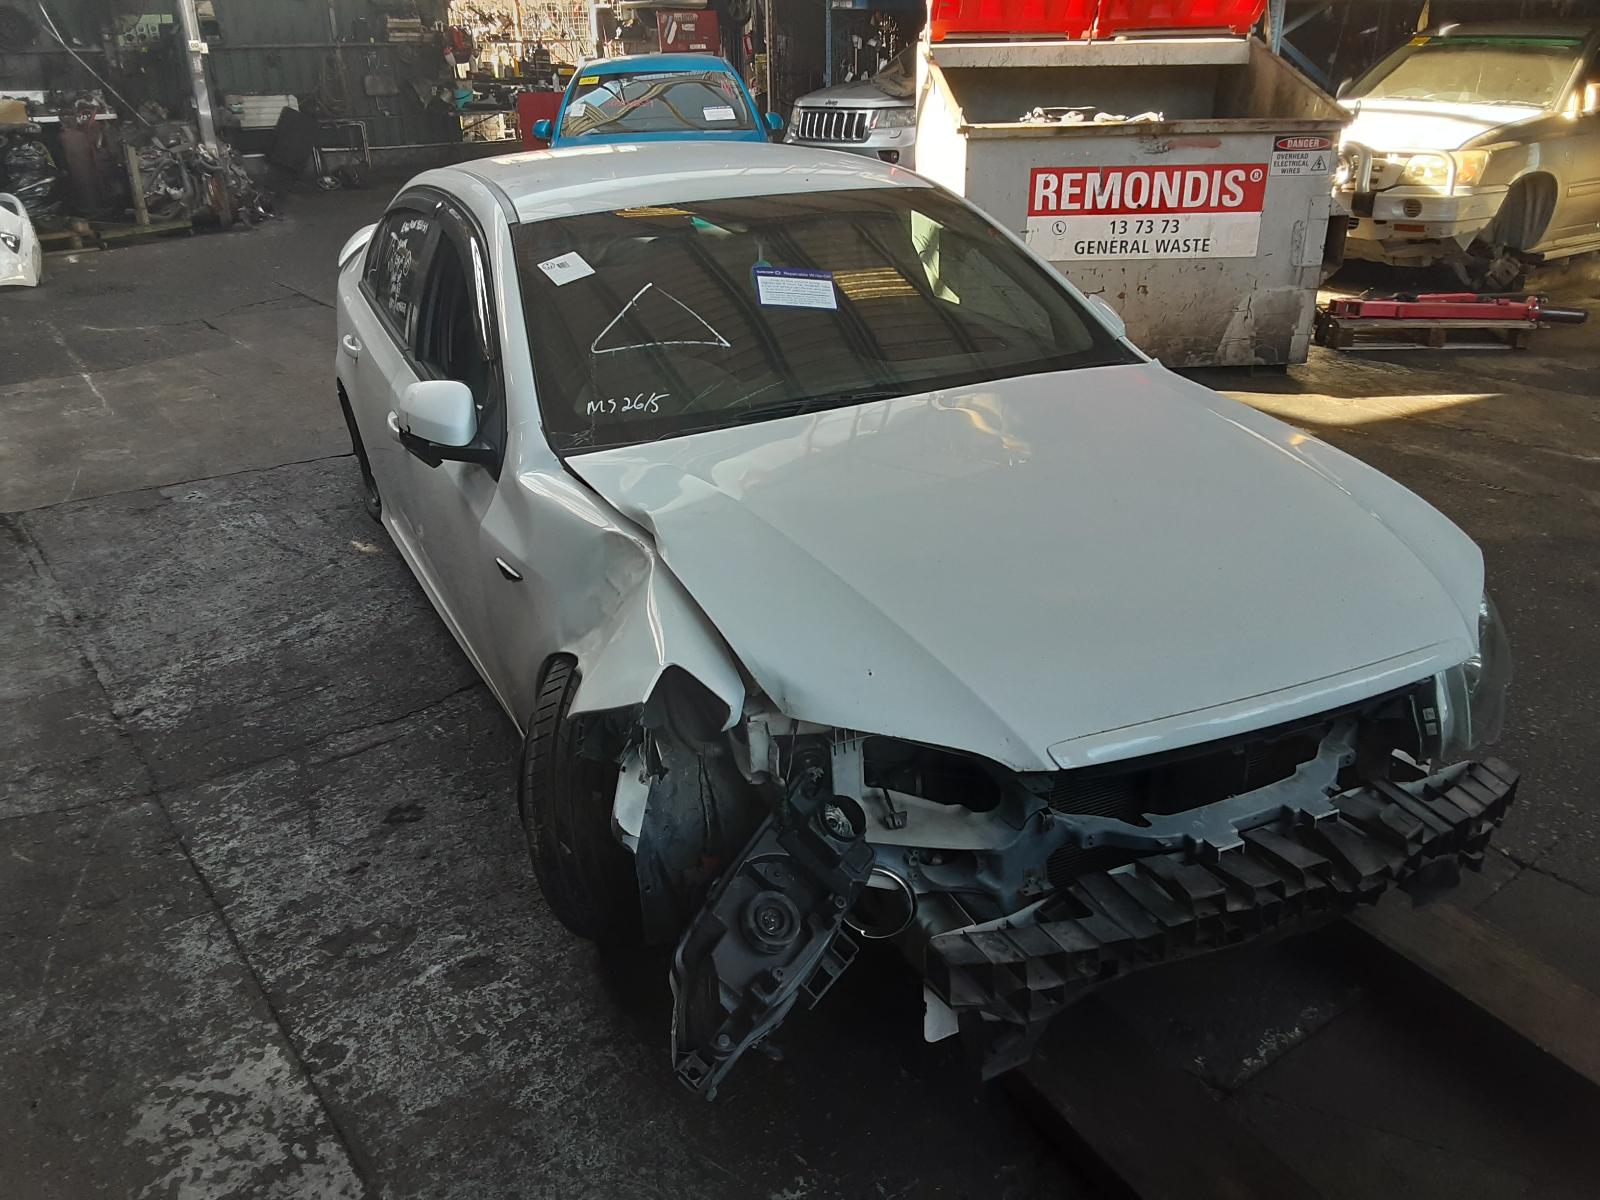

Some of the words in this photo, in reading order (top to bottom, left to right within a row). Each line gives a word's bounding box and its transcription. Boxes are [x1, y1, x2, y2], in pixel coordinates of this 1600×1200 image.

[1287, 138, 1320, 148] DANGER
[1110, 220, 1128, 235] 13
[1135, 220, 1154, 234] 73
[1161, 219, 1180, 234] 73
[1074, 239, 1149, 255] GENERAL
[1155, 238, 1211, 253] WASTE
